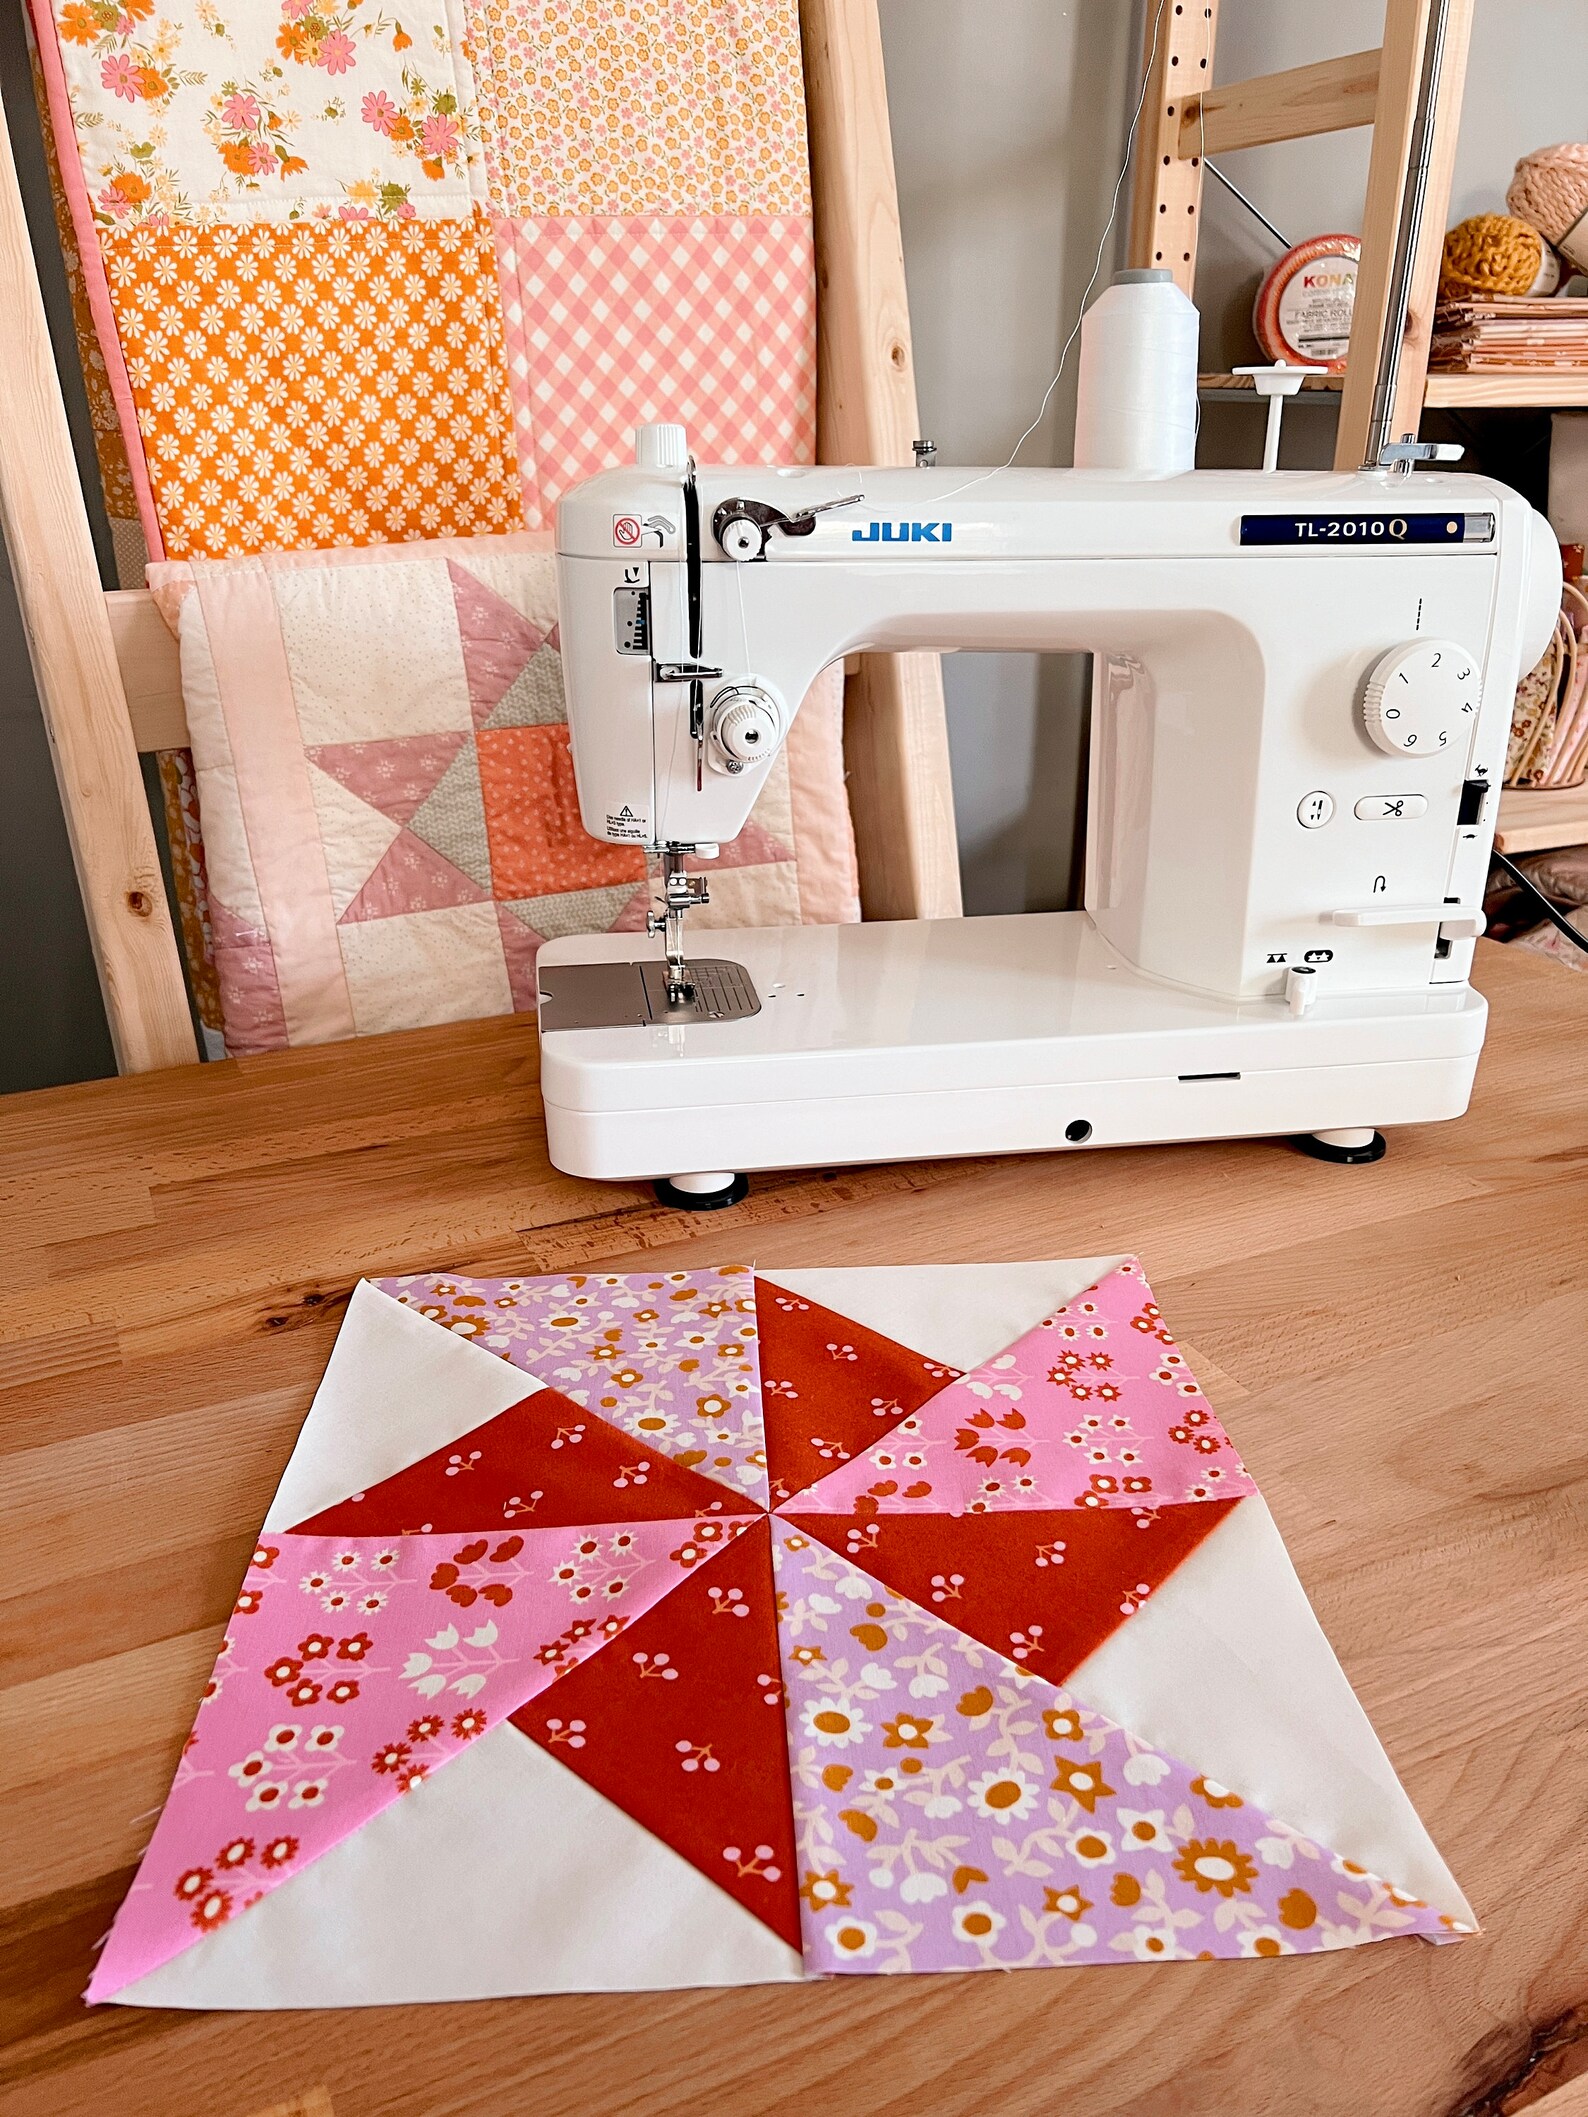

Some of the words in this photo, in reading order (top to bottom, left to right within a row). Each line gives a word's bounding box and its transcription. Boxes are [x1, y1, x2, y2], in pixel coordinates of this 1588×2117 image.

[1303, 273, 1354, 288] KONA
[851, 522, 953, 542] JUKI
[1294, 518, 1408, 540] TL-2010Q
[1431, 652, 1442, 668] 2
[1399, 672, 1409, 684] 1
[1457, 668, 1471, 680] 3
[1385, 708, 1401, 719] 0
[1461, 702, 1473, 713] 4
[1403, 734, 1418, 747] 6
[1438, 731, 1447, 746] 5
